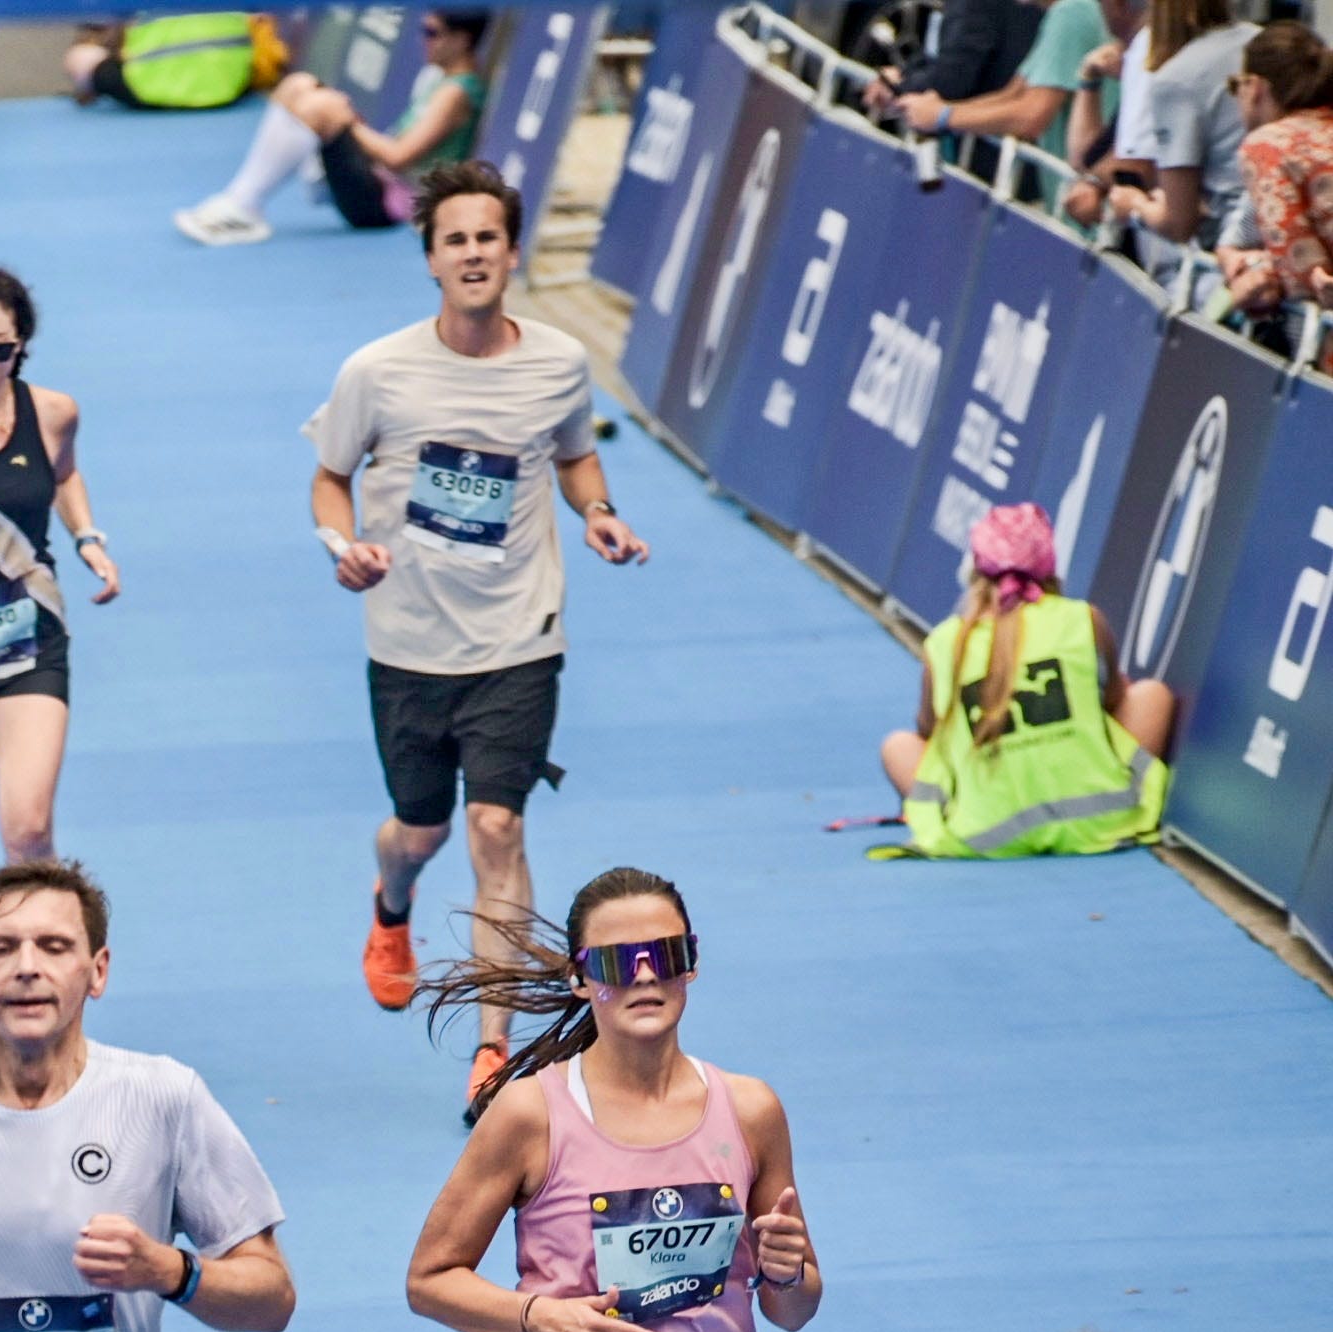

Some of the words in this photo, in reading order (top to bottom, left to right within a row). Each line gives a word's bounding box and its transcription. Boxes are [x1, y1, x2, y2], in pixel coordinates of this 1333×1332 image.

[431, 471, 504, 500] 63088
[628, 1222, 717, 1255] 67077
[650, 1251, 687, 1265] Klara
[640, 1276, 701, 1307] zalando
